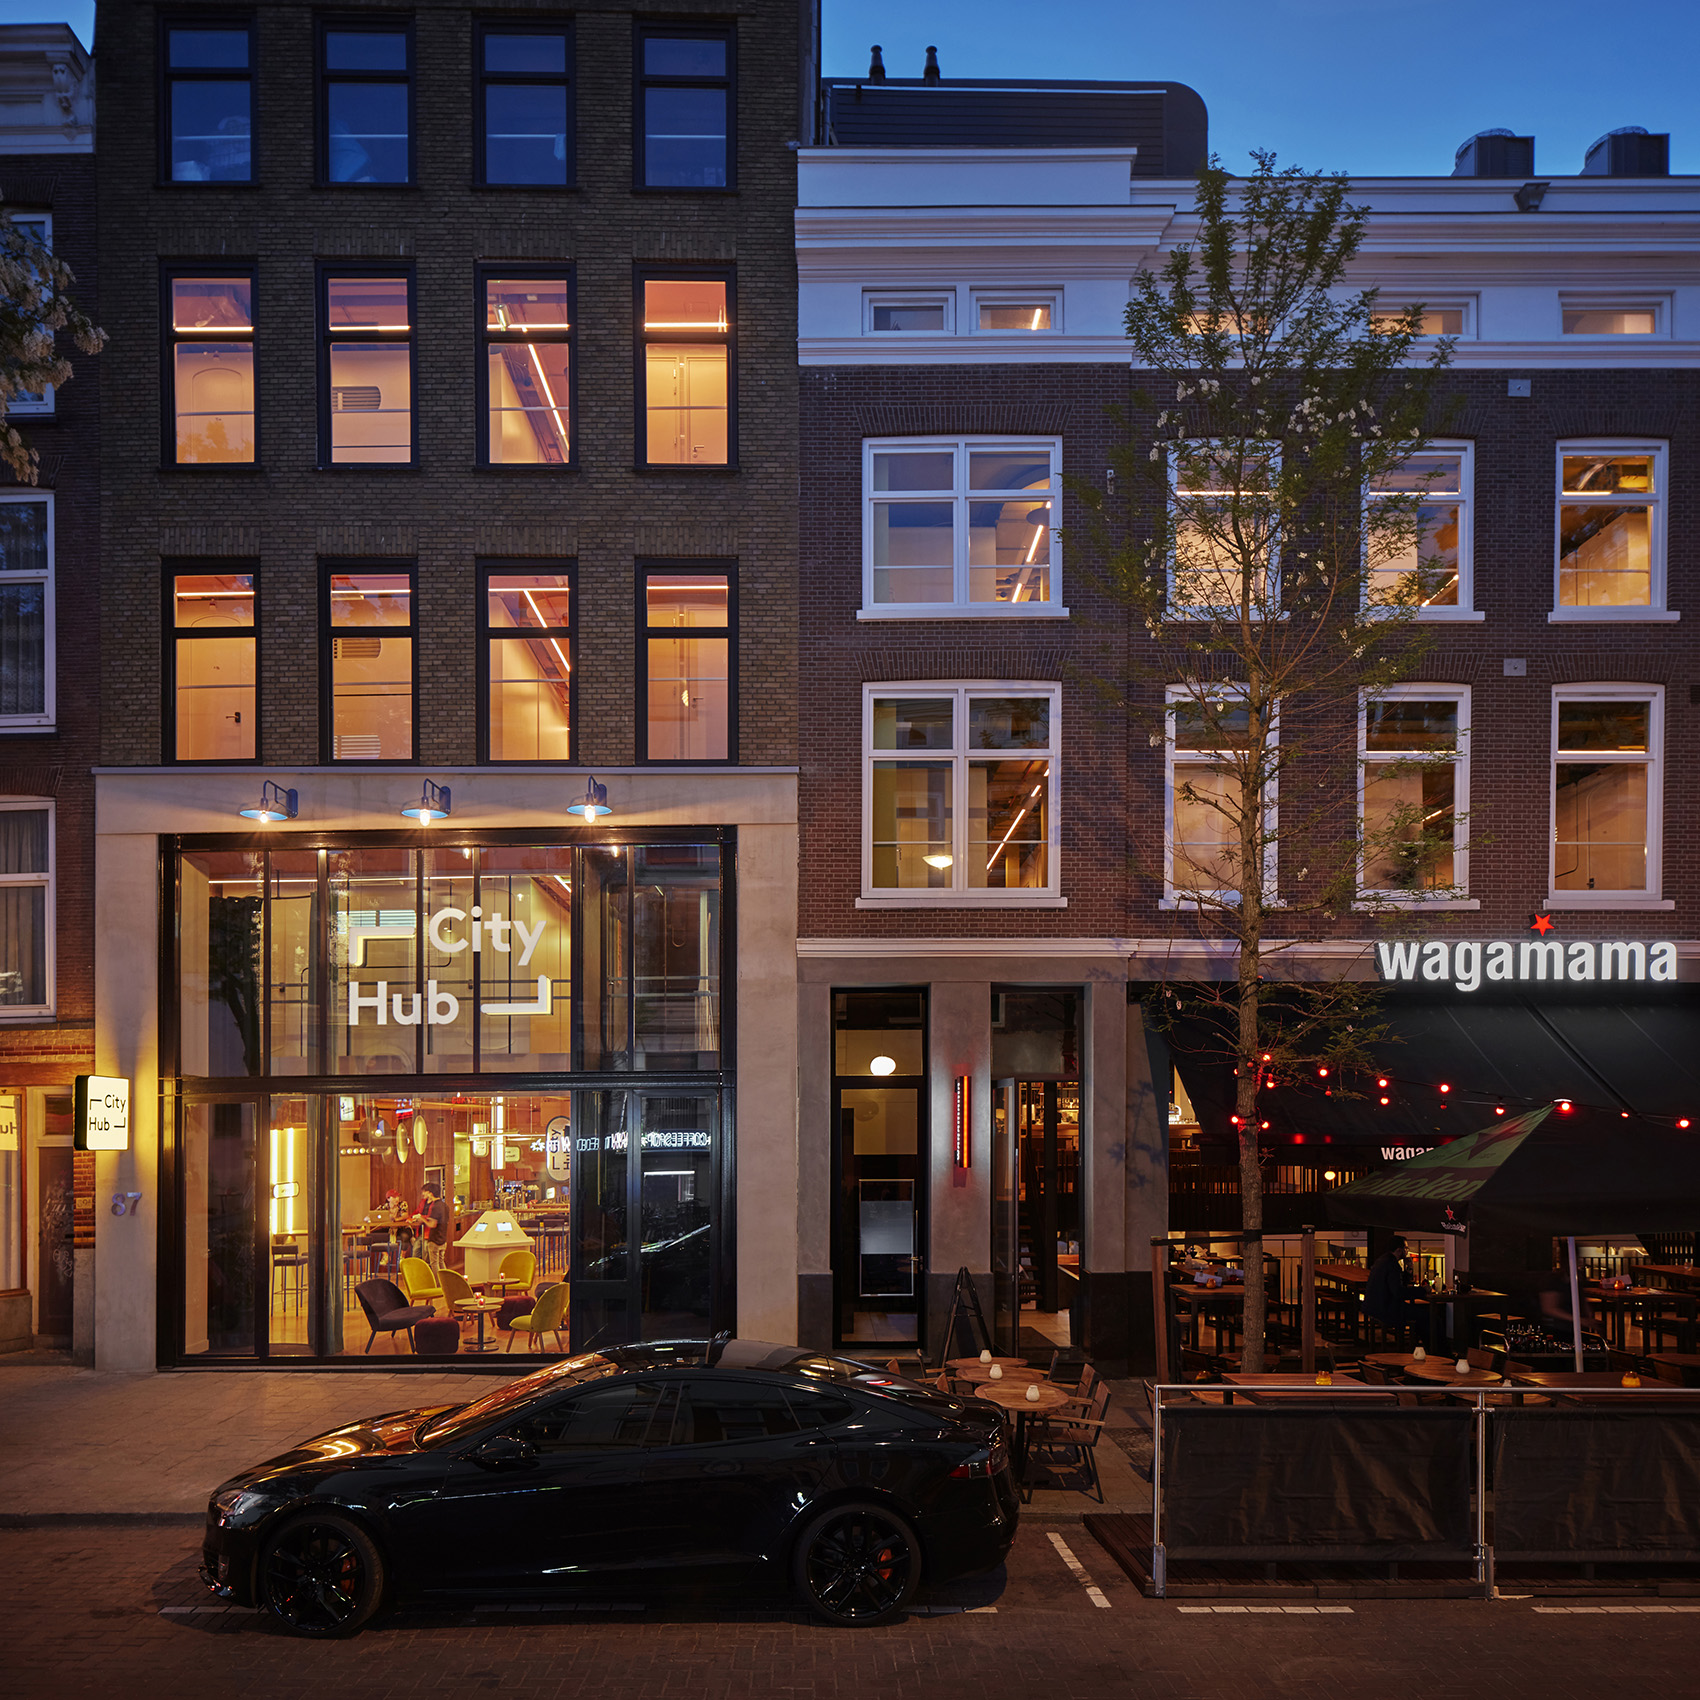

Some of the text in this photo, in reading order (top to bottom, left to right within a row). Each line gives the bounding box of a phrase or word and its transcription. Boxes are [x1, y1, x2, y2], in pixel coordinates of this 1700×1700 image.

[429, 906, 547, 966] City
[1378, 941, 1678, 992] wagamama
[349, 980, 459, 1025] Hub
[104, 1094, 126, 1113] City
[89, 1117, 110, 1131] Hub
[1381, 1147, 1435, 1161] waga
[111, 1192, 142, 1216] 87
